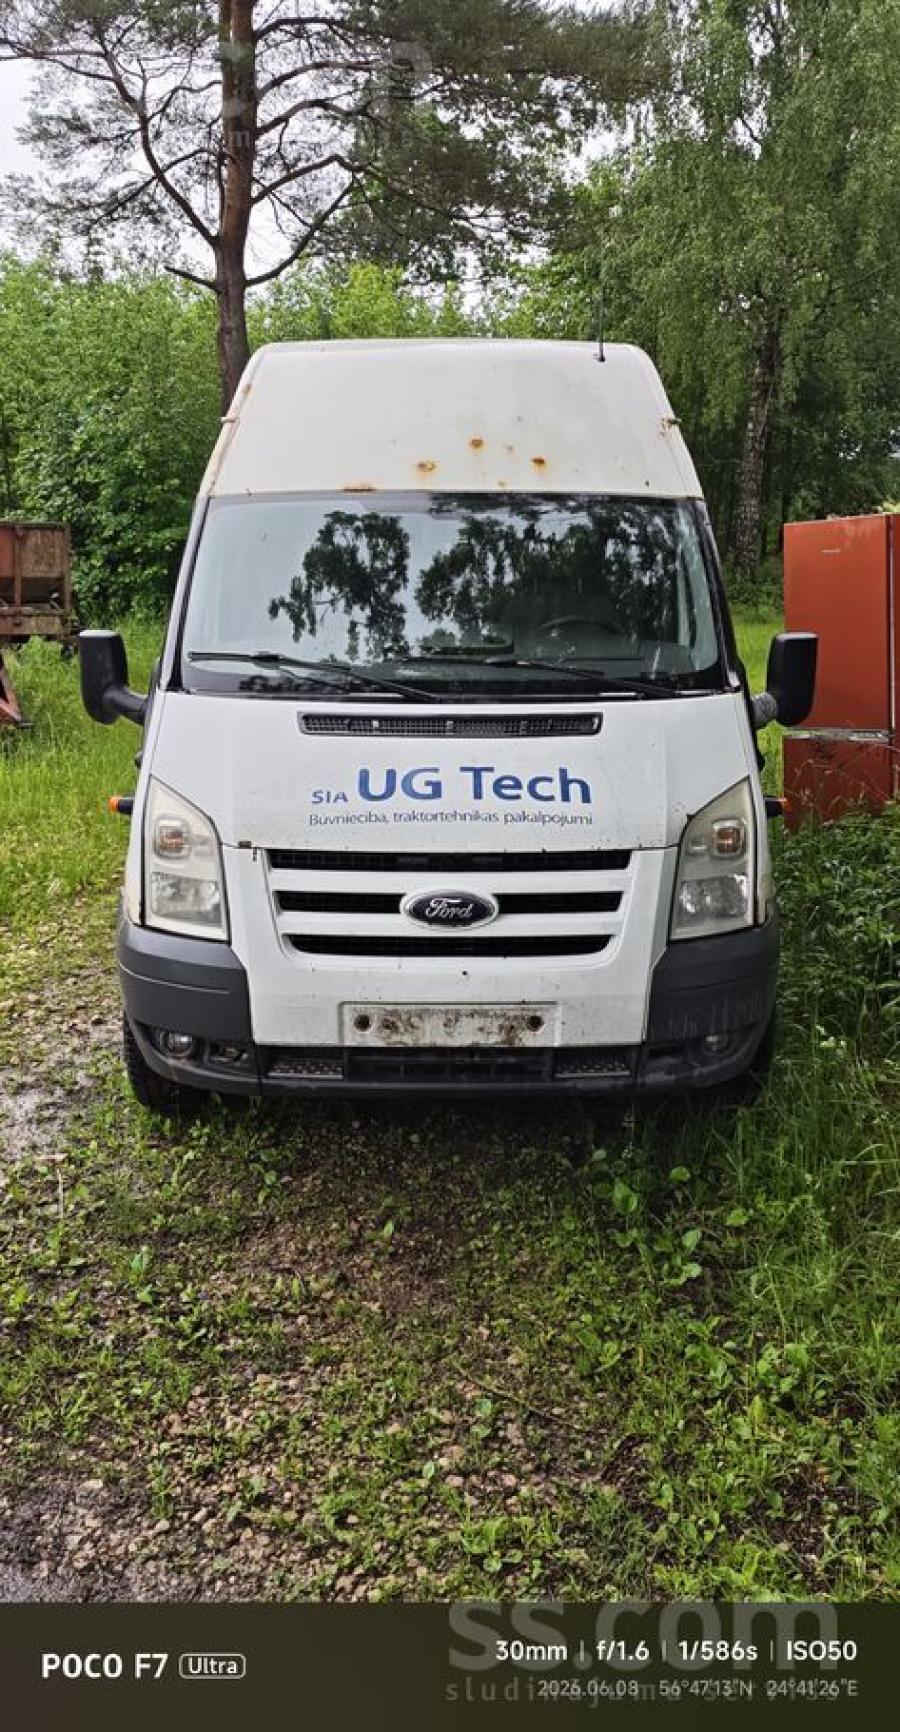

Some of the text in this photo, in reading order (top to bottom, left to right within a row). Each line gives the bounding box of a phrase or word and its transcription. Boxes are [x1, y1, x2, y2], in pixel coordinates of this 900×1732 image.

[311, 766, 592, 805] SIA UG Tech
[393, 808, 500, 824] traktortehnikas
[503, 809, 593, 827] pakalpojumi
[425, 898, 473, 919] Ford
